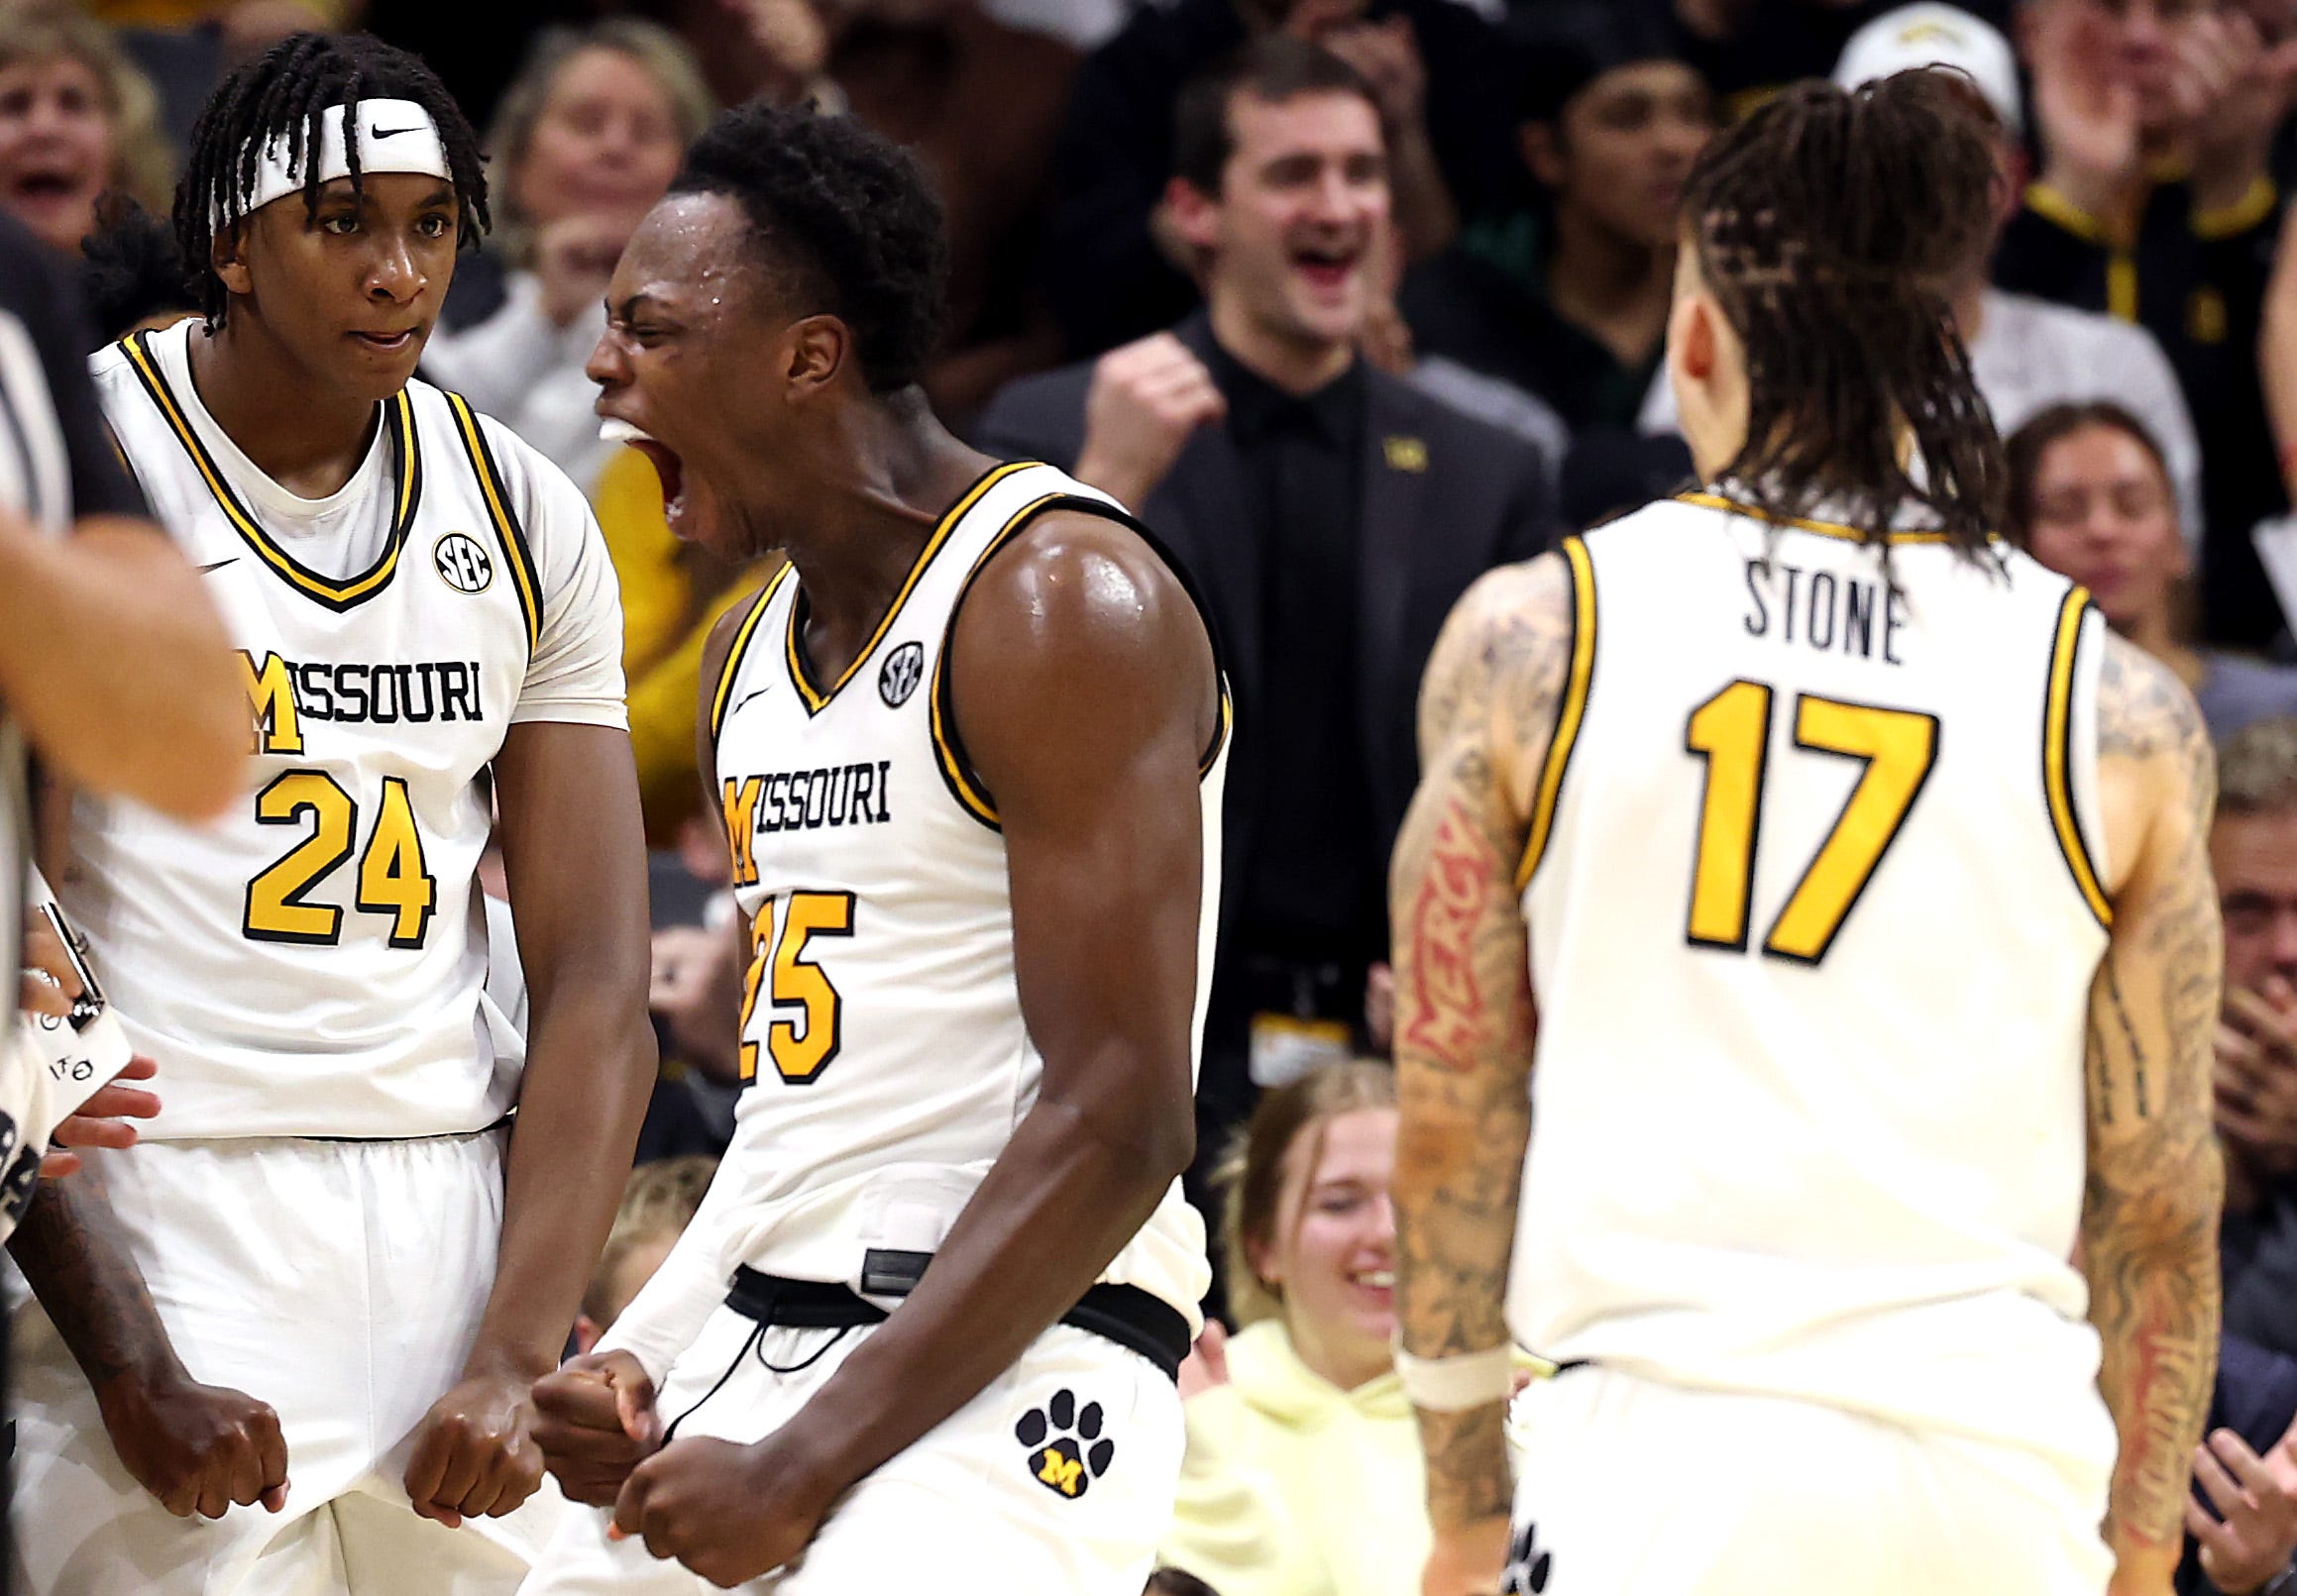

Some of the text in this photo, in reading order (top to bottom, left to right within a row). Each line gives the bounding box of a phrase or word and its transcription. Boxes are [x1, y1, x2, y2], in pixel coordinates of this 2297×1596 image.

[436, 536, 492, 591] SEC
[1744, 559, 1904, 666] STONE
[238, 649, 484, 756] MISSOURI
[880, 644, 922, 705] SEC
[243, 769, 437, 950] 24
[723, 760, 891, 888] MISSOURI
[1684, 678, 1940, 966] 17
[1406, 798, 1494, 1073] MERCY
[1038, 1447, 1083, 1496] M
